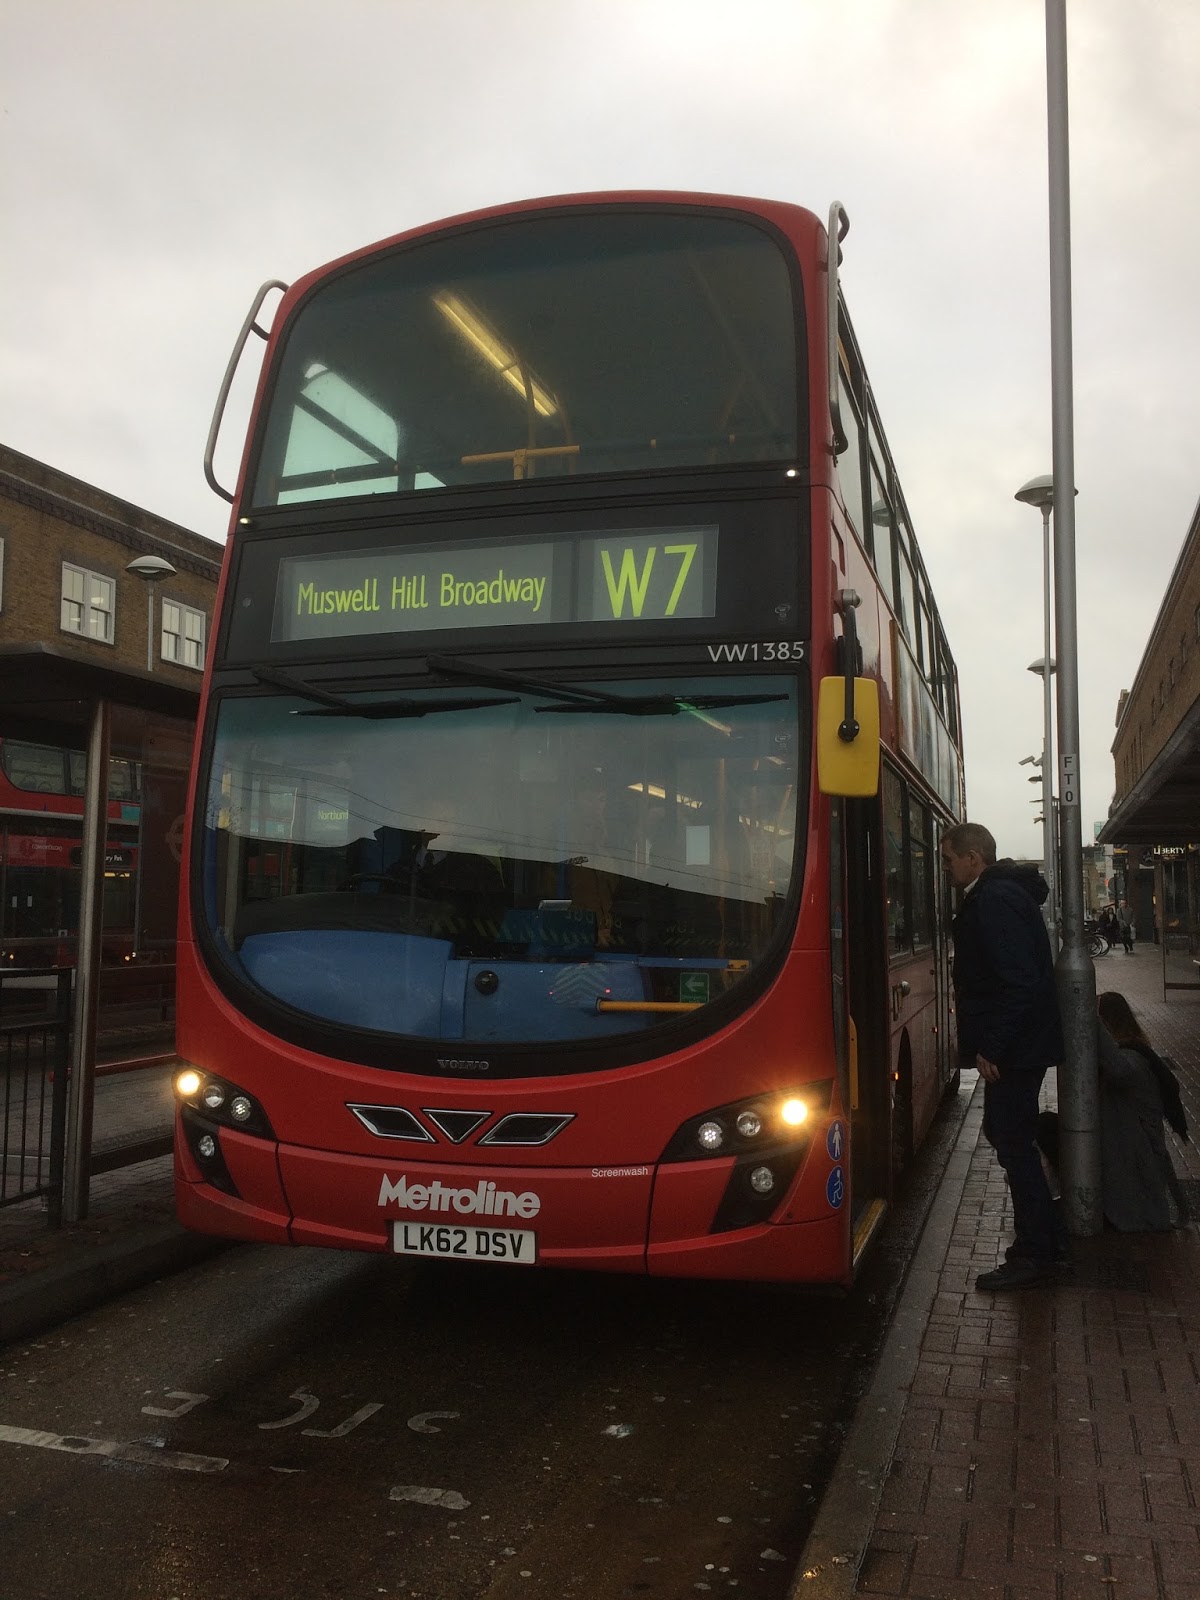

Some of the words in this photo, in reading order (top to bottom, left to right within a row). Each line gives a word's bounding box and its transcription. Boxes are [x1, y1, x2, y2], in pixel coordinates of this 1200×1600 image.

[297, 578, 379, 615] Muswell
[391, 575, 428, 610] Hill
[440, 570, 546, 612] Broadway
[601, 543, 697, 619] W7
[707, 641, 805, 663] VW1385
[437, 1059, 490, 1071] VOLVO
[591, 1166, 649, 1179] Screenwash
[378, 1173, 541, 1219] Metroline
[403, 1224, 468, 1255] LK62
[475, 1230, 524, 1259] DSV
